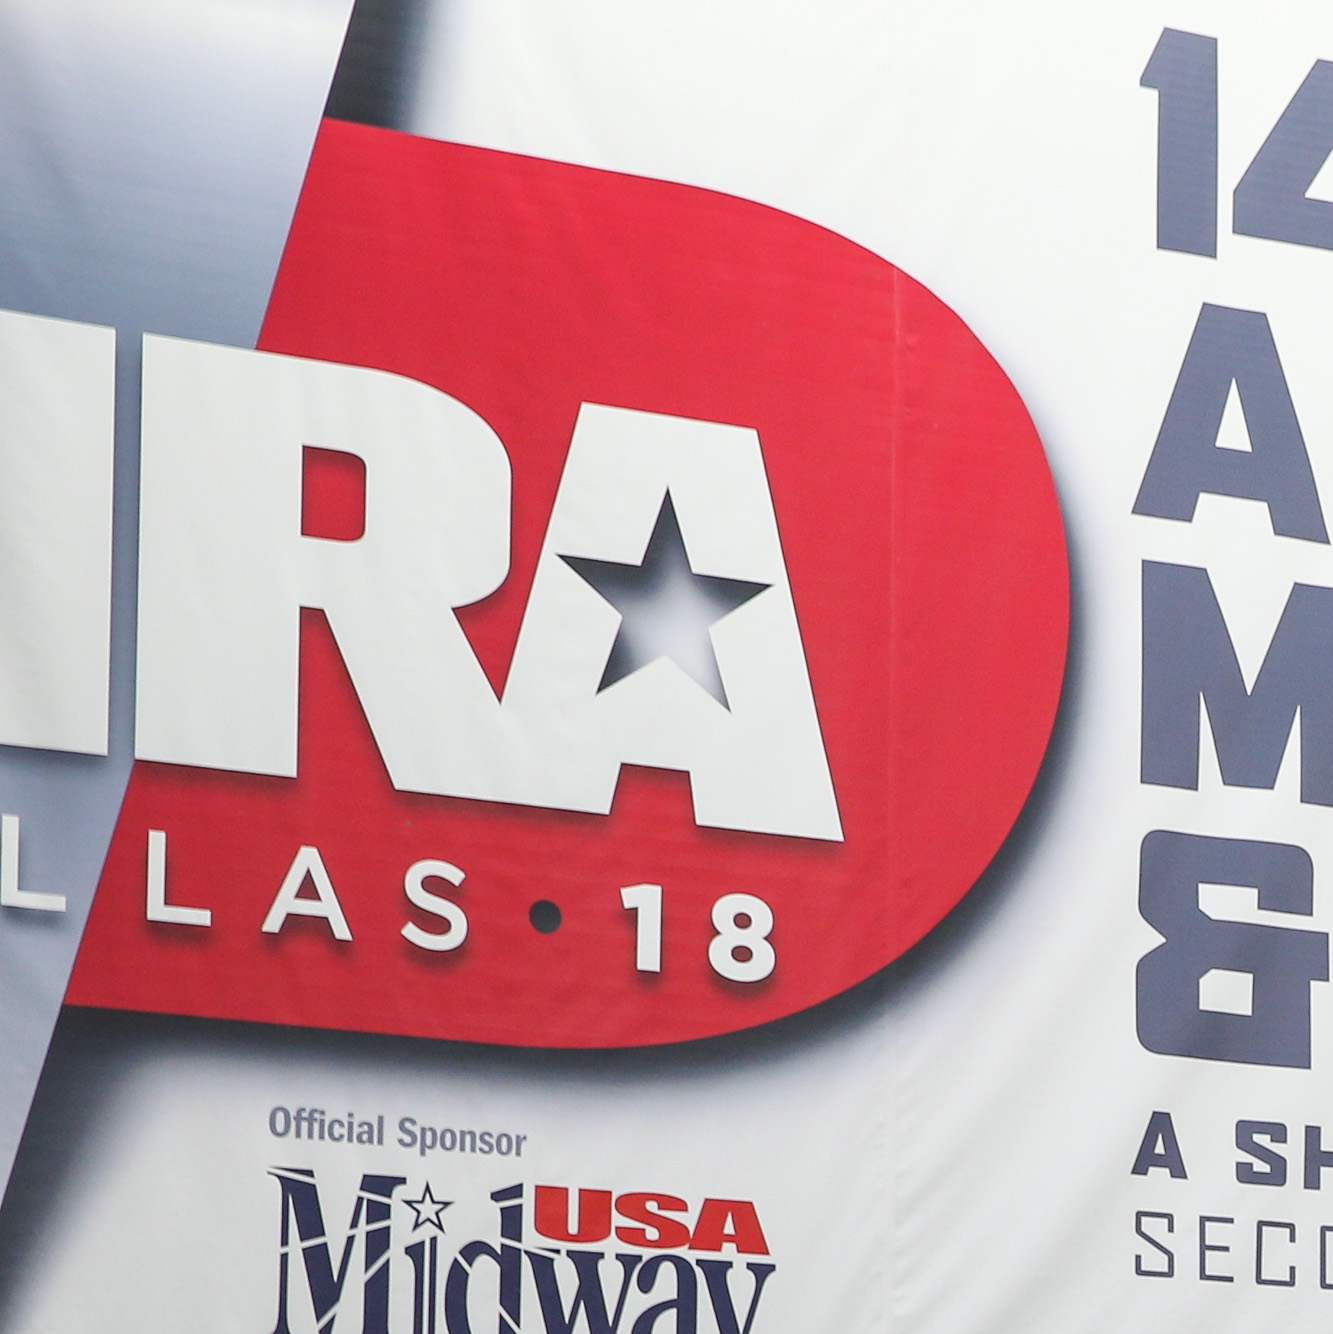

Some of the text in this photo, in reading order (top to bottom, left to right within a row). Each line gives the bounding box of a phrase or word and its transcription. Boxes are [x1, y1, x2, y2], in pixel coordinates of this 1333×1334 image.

[619, 882, 776, 983] 18
[1134, 828, 1330, 1070] &
[268, 1106, 527, 1158] Official Sponsor
[1130, 1111, 1189, 1181] A
[533, 1184, 770, 1256] USA
